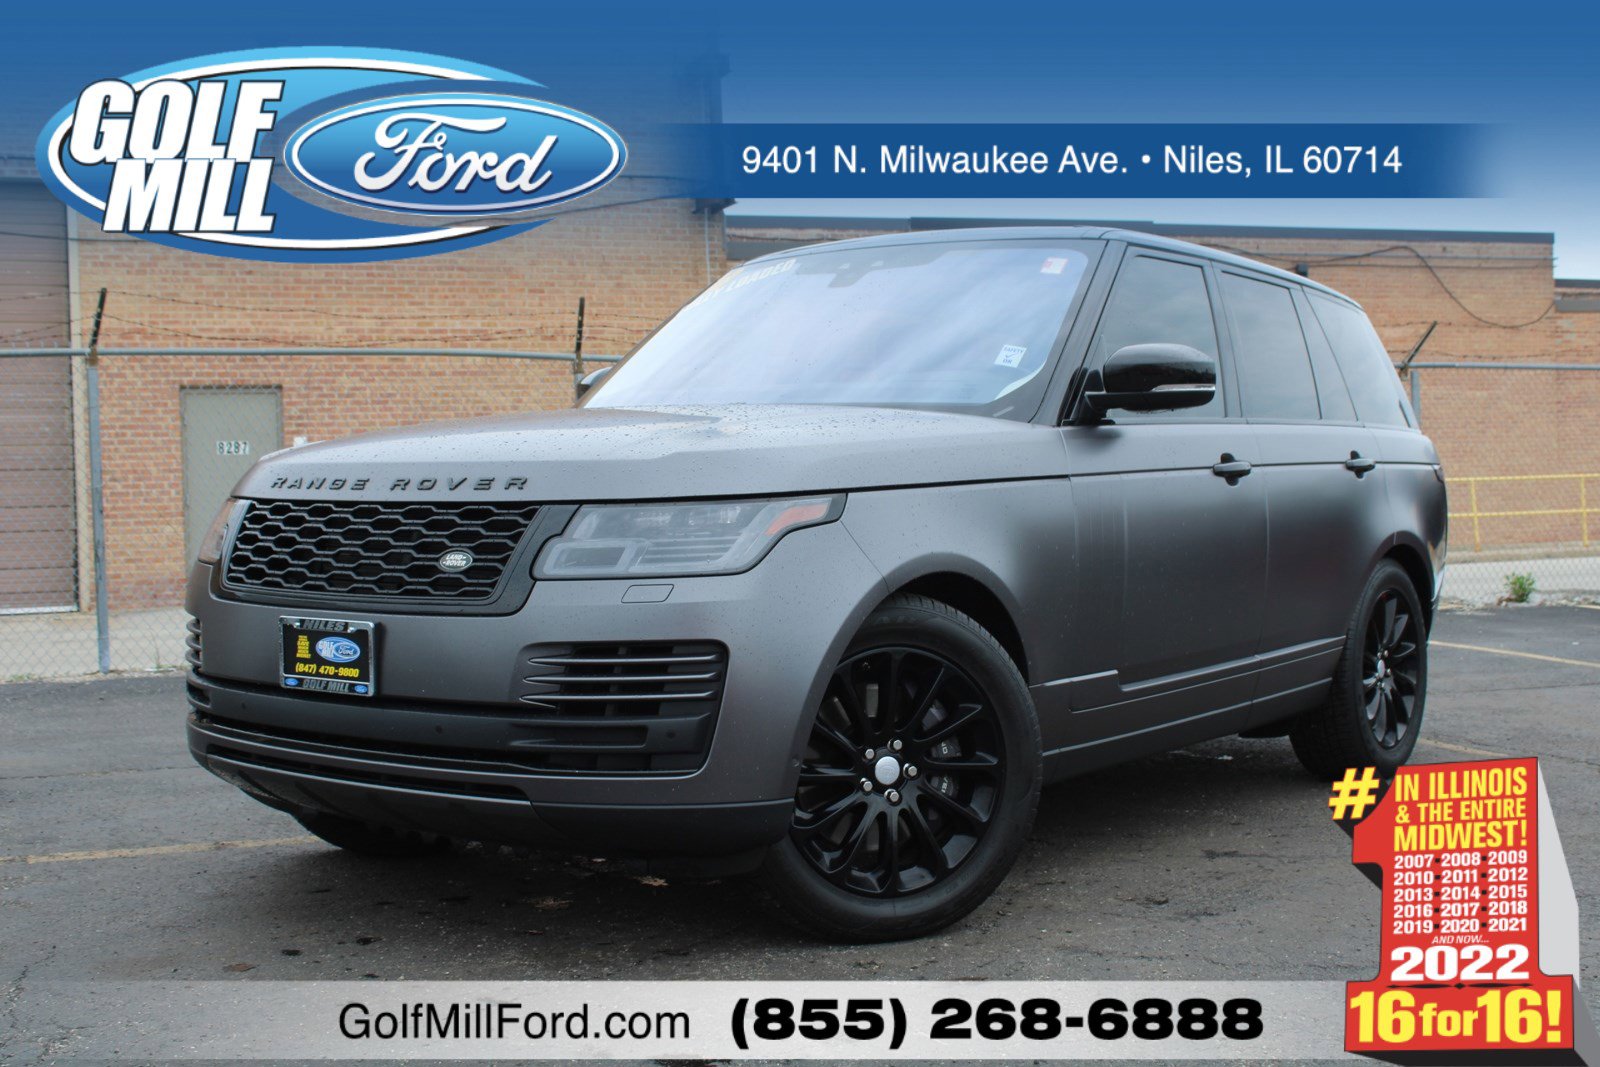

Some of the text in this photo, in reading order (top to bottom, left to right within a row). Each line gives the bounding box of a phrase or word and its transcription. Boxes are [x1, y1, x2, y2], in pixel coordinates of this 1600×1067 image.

[218, 441, 248, 455] 8287
[270, 477, 527, 491] RANGE ROVER
[295, 662, 359, 678] (847) 470-9800
